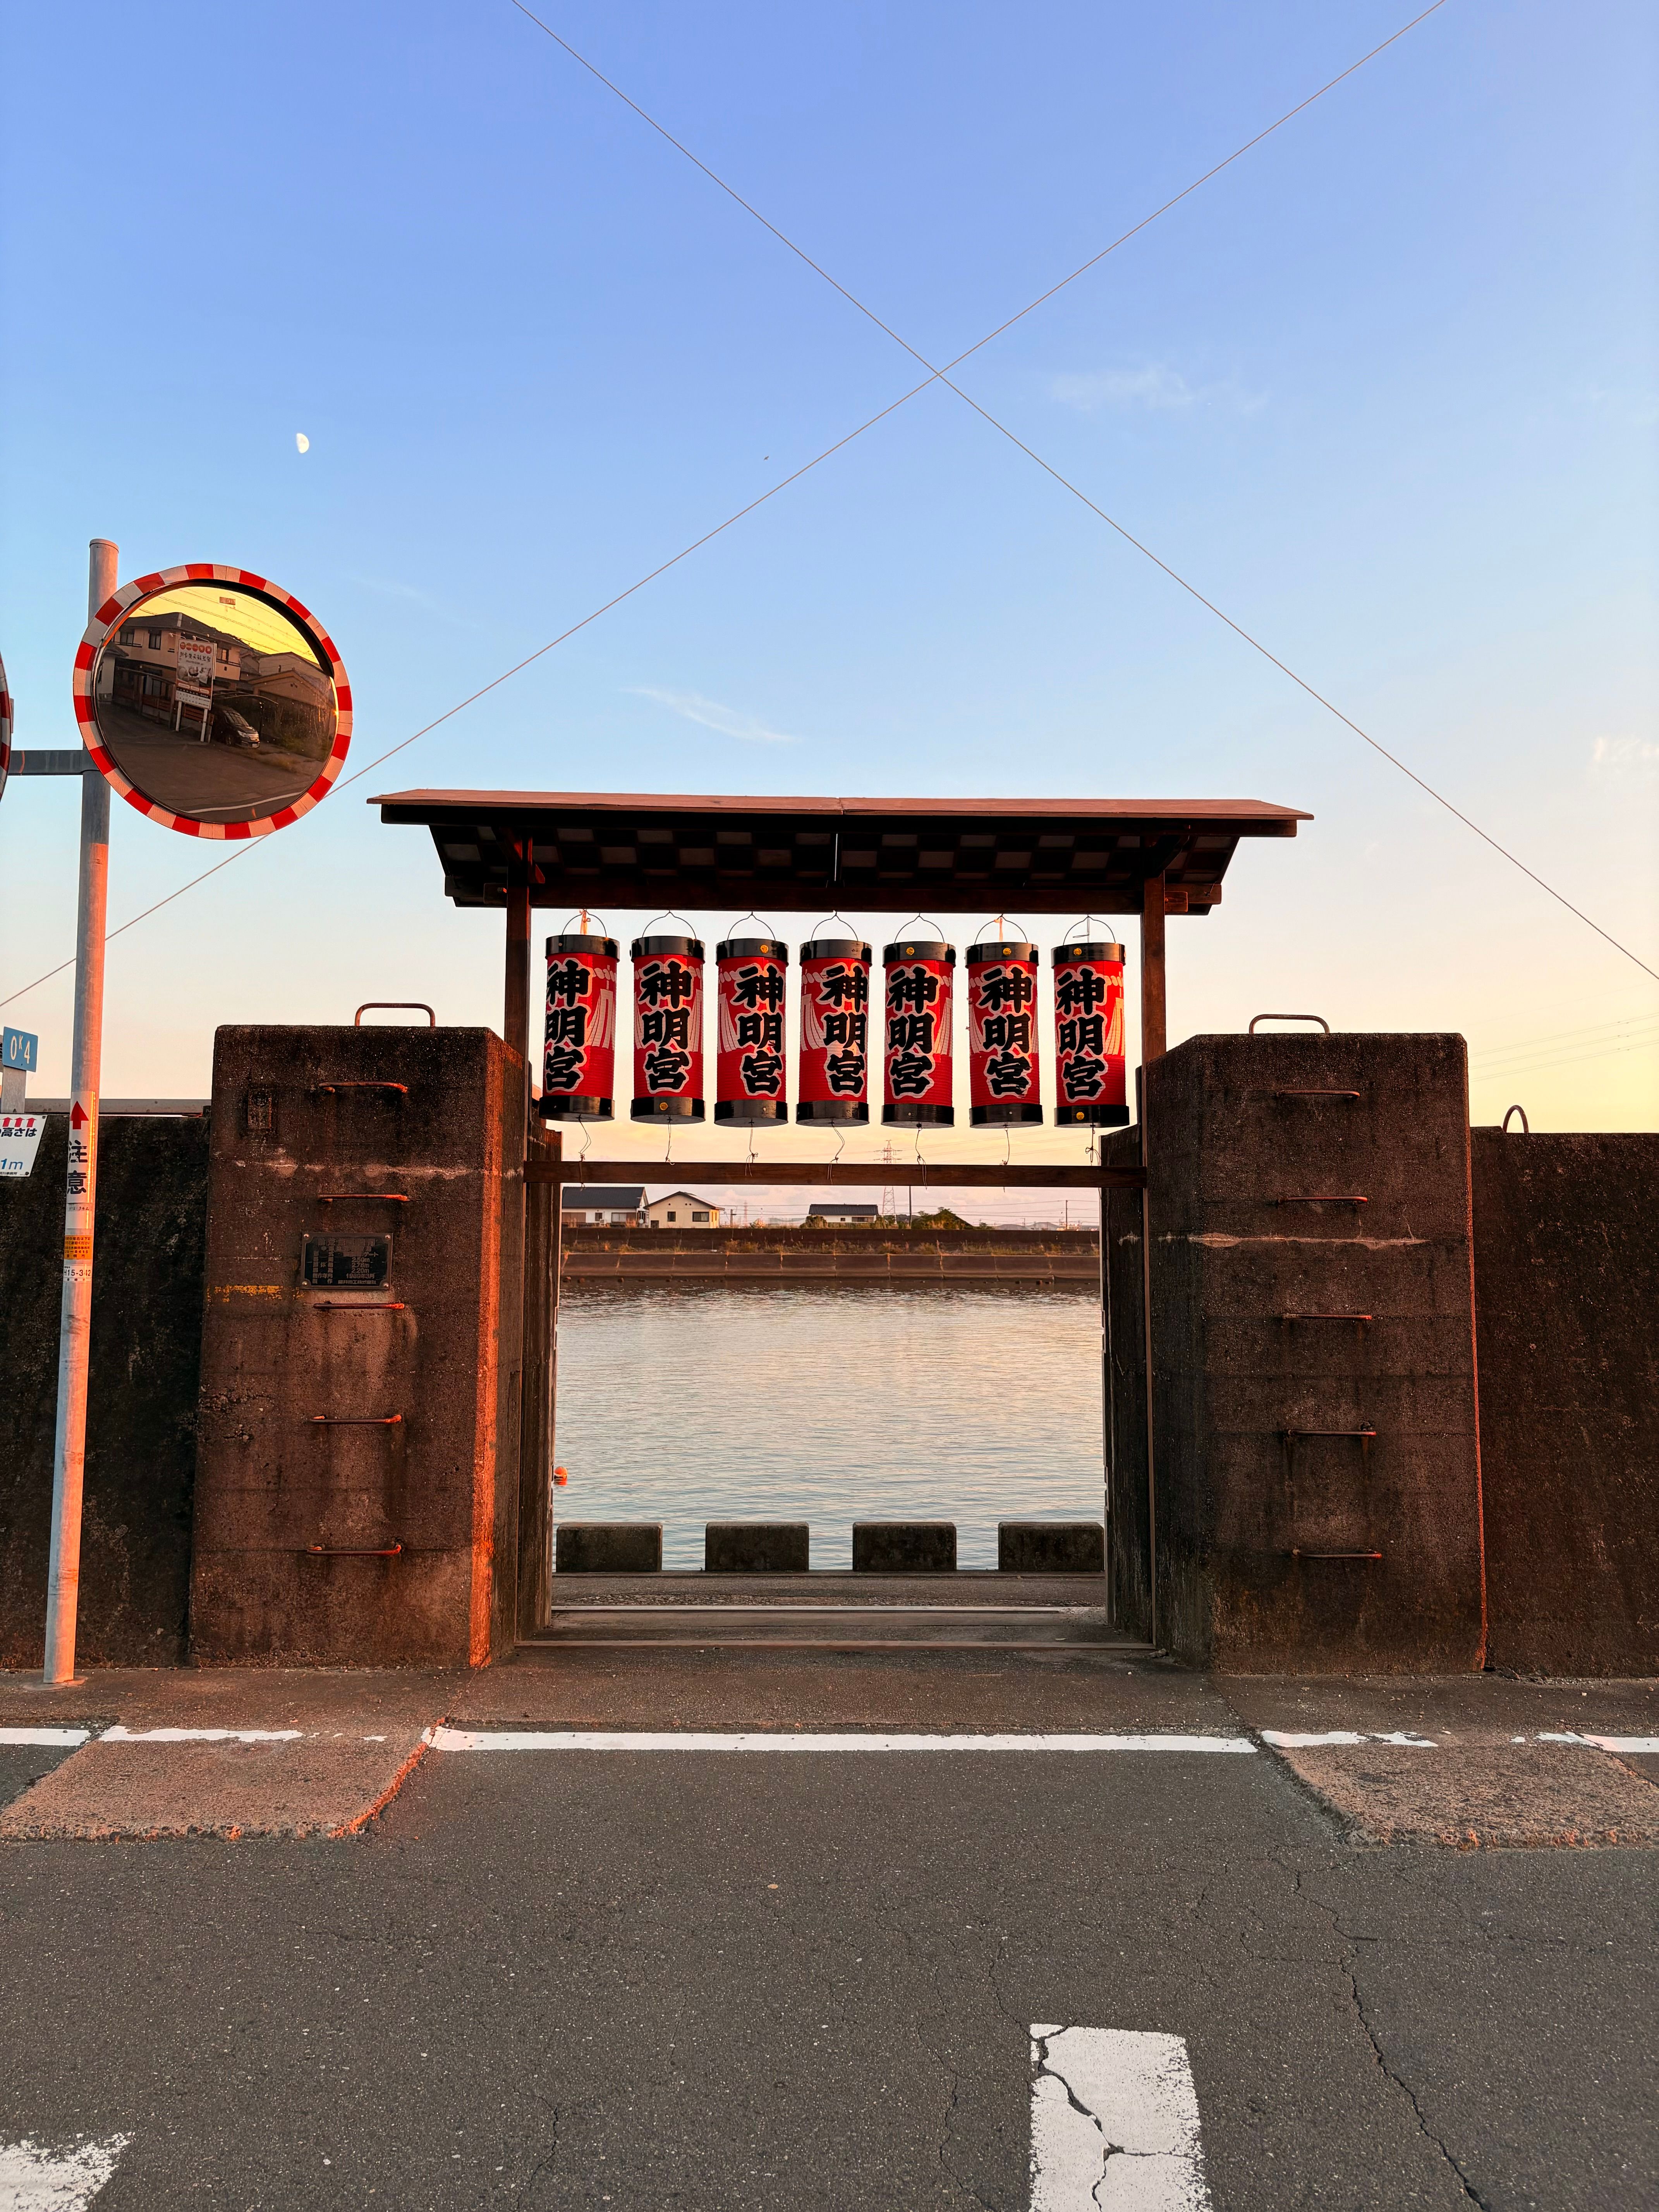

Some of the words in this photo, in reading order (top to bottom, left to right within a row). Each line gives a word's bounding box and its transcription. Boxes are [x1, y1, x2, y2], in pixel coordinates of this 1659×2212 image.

[546, 959, 590, 1091] 神明宮
[639, 960, 692, 1091] 神明宮
[733, 965, 784, 1094] 神明宮
[823, 965, 868, 1095] 神明宮
[887, 966, 939, 1097] 神明宮
[979, 967, 1032, 1096] 神明宮
[1056, 968, 1106, 1100] 神明宮
[0, 1128, 37, 1137] 高さは
[67, 1140, 88, 1194] 注意
